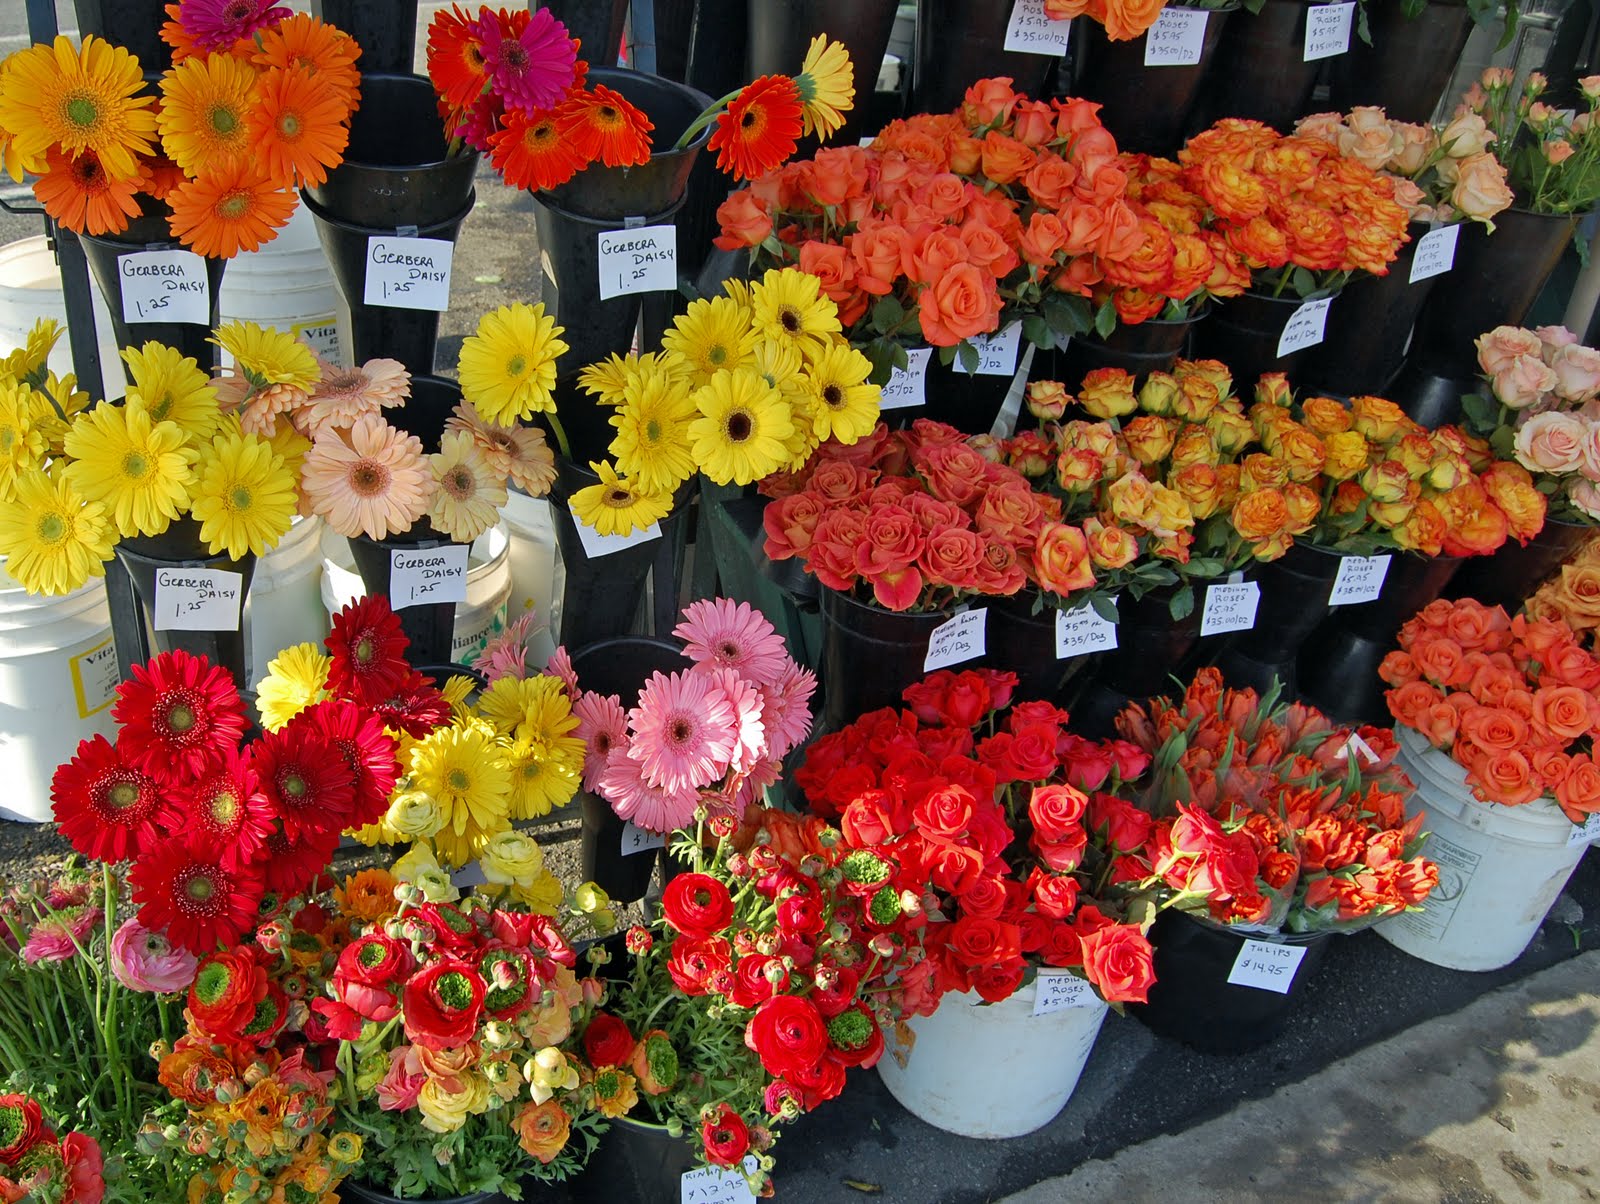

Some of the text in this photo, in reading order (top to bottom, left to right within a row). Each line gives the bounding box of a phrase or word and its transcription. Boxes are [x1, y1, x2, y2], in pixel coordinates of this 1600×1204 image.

[601, 238, 657, 255] GERBERA
[372, 243, 434, 268] GERBERA
[632, 249, 674, 265] DAISY
[122, 259, 185, 277] GERBERA
[408, 268, 447, 283] DAISY
[619, 267, 648, 289] 1.25
[162, 280, 205, 294] DAISY
[383, 281, 415, 299] 1.25
[136, 296, 170, 318] 1.25
[394, 553, 446, 569] GERBERA
[159, 571, 214, 589] GERBERA
[421, 567, 462, 579] DAISY
[196, 589, 235, 600] DAISY
[411, 581, 441, 600] 1.25
[175, 600, 206, 617] 1.25
[453, 626, 490, 650] liance
[1241, 959, 1289, 975] $14.95
[1050, 986, 1084, 994] ROSES
